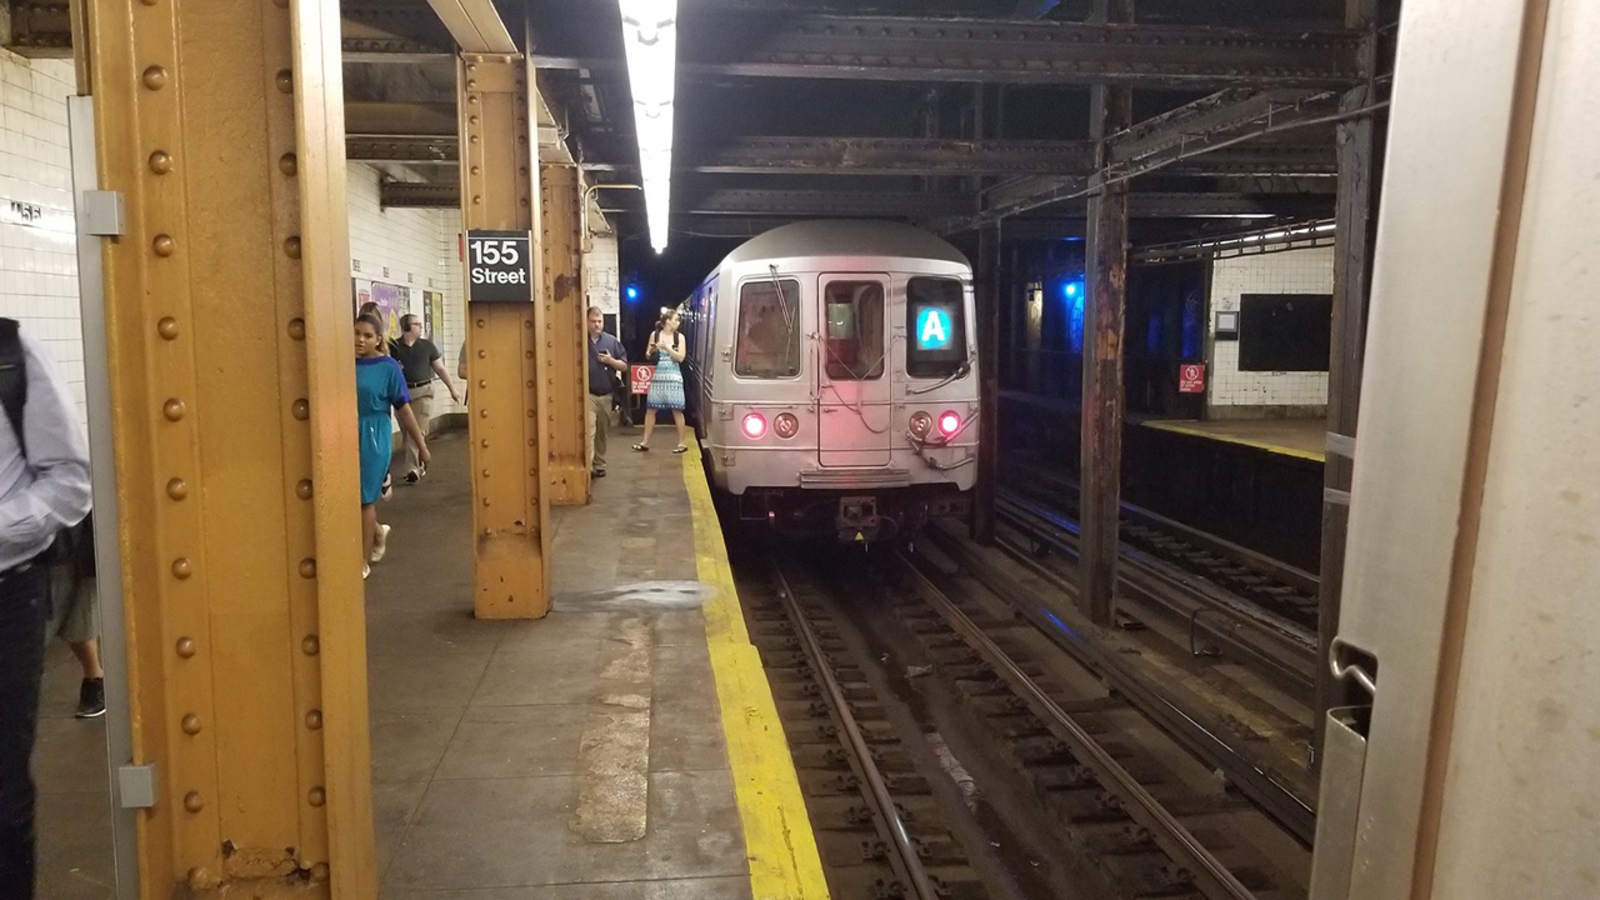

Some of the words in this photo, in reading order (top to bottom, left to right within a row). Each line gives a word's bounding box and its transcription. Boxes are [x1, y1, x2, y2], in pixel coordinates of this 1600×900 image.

[470, 240, 520, 265] 155
[471, 267, 526, 285] Street
[922, 310, 945, 341] A
